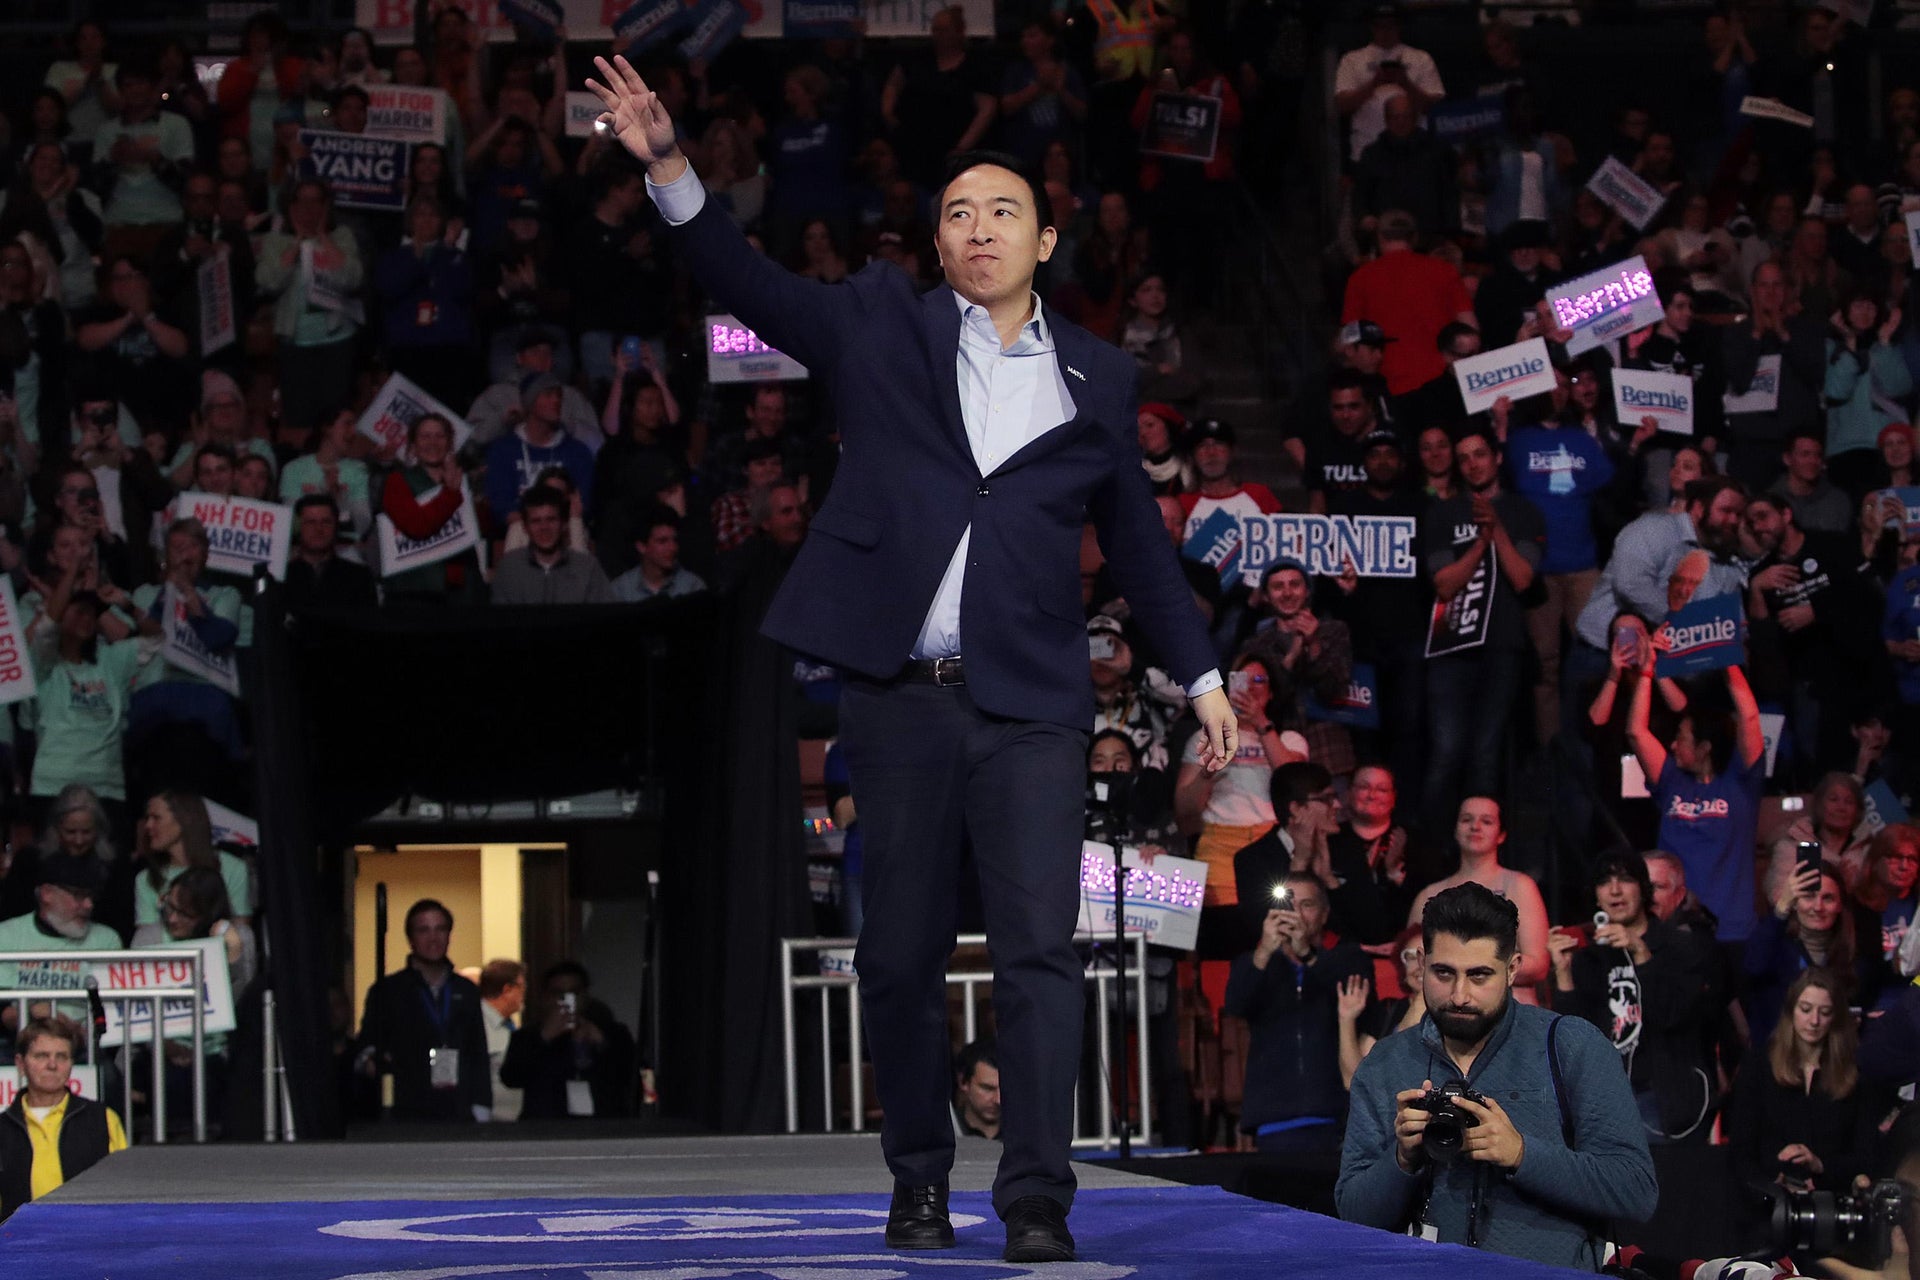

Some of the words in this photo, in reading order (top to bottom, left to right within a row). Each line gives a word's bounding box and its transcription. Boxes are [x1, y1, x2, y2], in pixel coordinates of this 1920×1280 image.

[311, 136, 397, 158] ANDREW
[310, 153, 396, 181] YANG
[1554, 271, 1652, 327] Bernie
[1466, 357, 1546, 391] Bernie
[1621, 385, 1689, 411] Bernie
[1322, 464, 1369, 482] TULS
[193, 503, 226, 525] NH
[231, 505, 275, 533] FOR
[206, 527, 271, 556] ARREN
[1242, 516, 1413, 574] BERNIE
[1458, 560, 1486, 635] ULSI
[1664, 616, 1736, 649] Bernie
[1082, 853, 1203, 907] Bernie
[1105, 907, 1159, 930] Brnie
[18, 971, 79, 988] WARREN
[108, 962, 147, 989] NH
